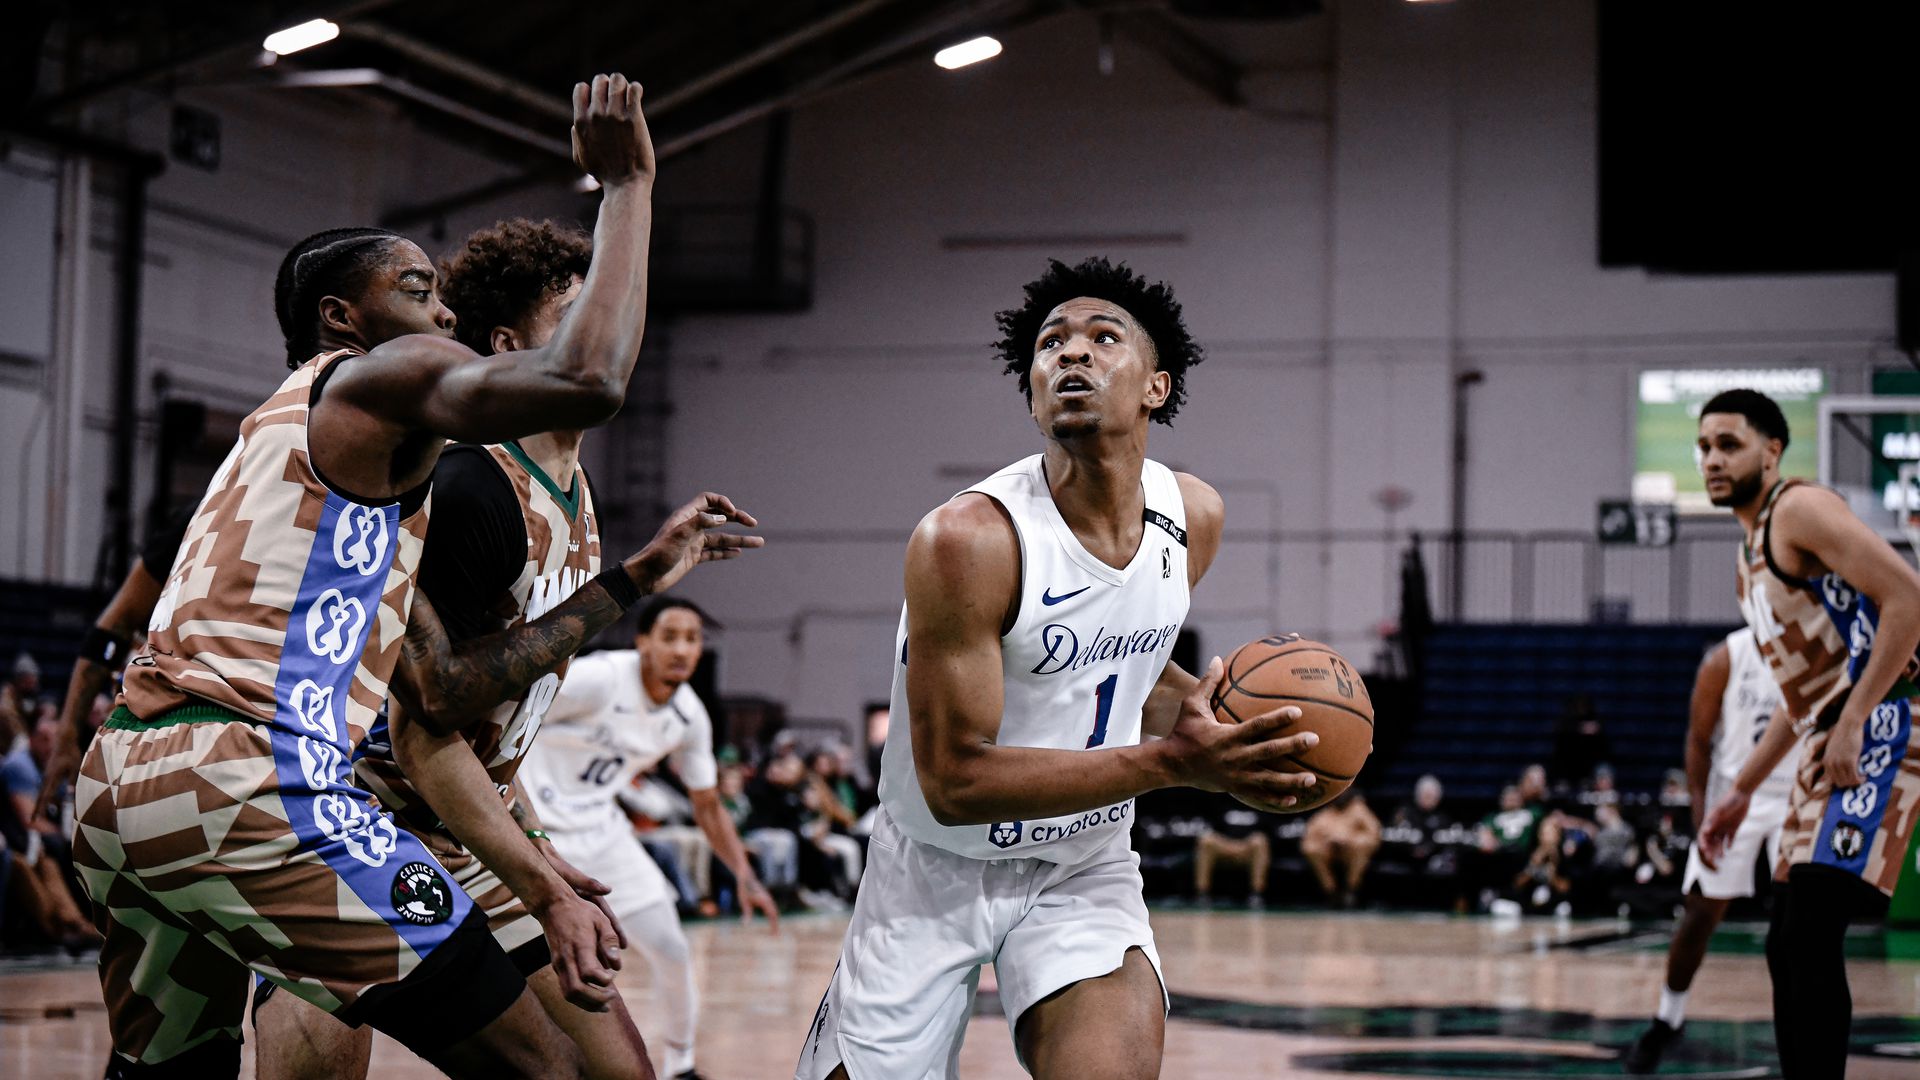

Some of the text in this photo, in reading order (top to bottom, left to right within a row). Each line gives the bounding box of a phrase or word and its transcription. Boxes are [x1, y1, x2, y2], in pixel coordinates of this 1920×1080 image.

[1155, 514, 1170, 531] BIG
[1031, 623, 1177, 675] Delaware
[1085, 673, 1119, 750] 1
[579, 756, 623, 787] 10
[1031, 800, 1134, 843] crypto.co
[399, 863, 435, 880] CELTICS
[396, 904, 435, 924] MAINE
